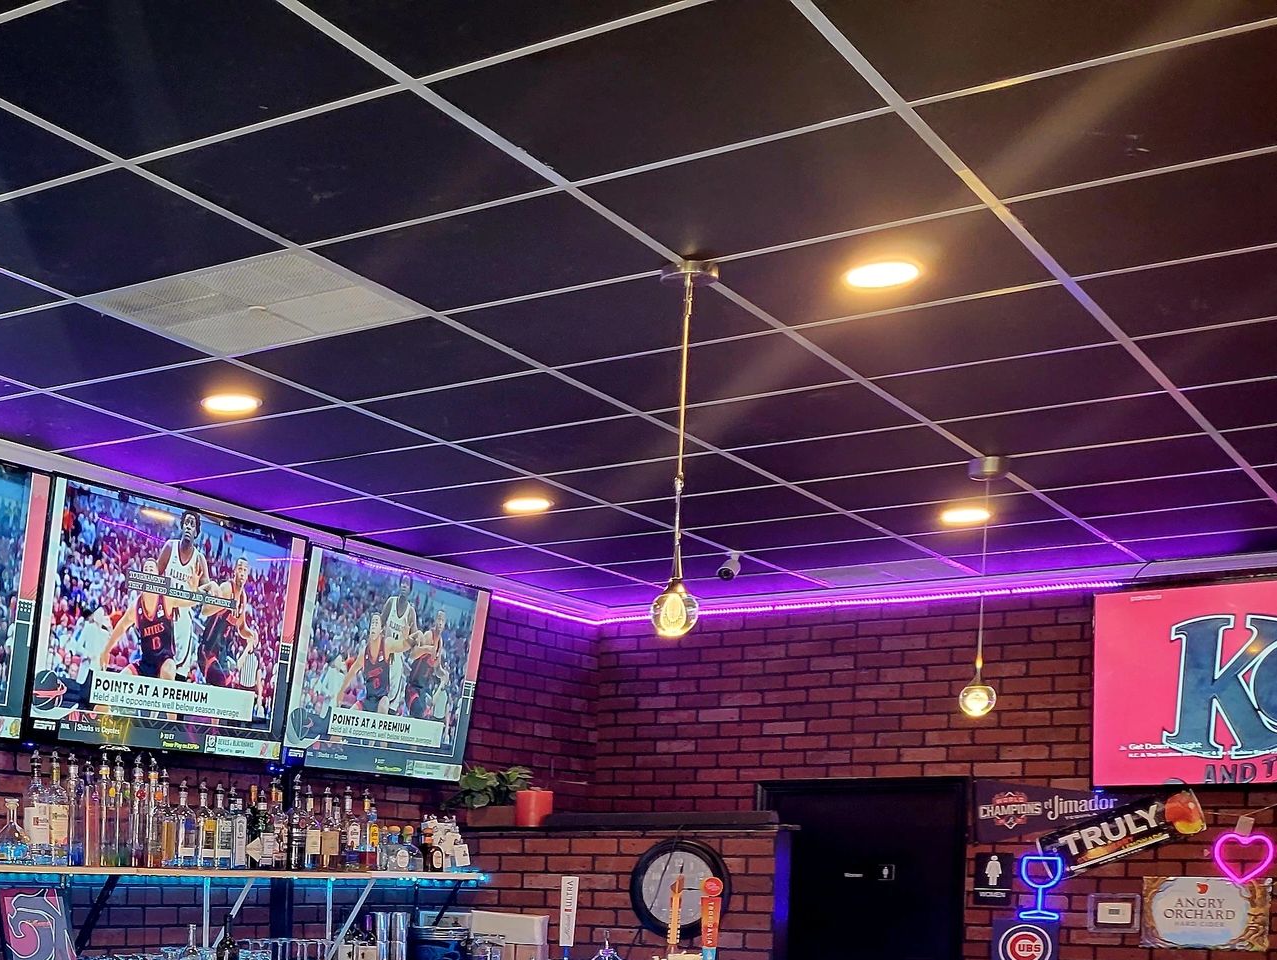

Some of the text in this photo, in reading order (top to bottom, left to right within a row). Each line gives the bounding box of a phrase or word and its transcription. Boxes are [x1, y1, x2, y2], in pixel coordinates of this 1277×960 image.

[95, 678, 209, 704] POINTS AT A PREMIUM
[92, 692, 240, 718] Held all 4 opponents well below season average
[77, 723, 94, 732] Sharks
[332, 713, 411, 734] POINTS AT A PREMIUM
[1204, 761, 1257, 784] AND
[979, 801, 1042, 819] CHAMPIONS
[1047, 794, 1118, 820] Jimador
[1057, 803, 1159, 856] TRULY
[565, 880, 574, 907] ULTRA
[1174, 897, 1225, 909] ANGRY
[1163, 908, 1236, 920] ORCHARD
